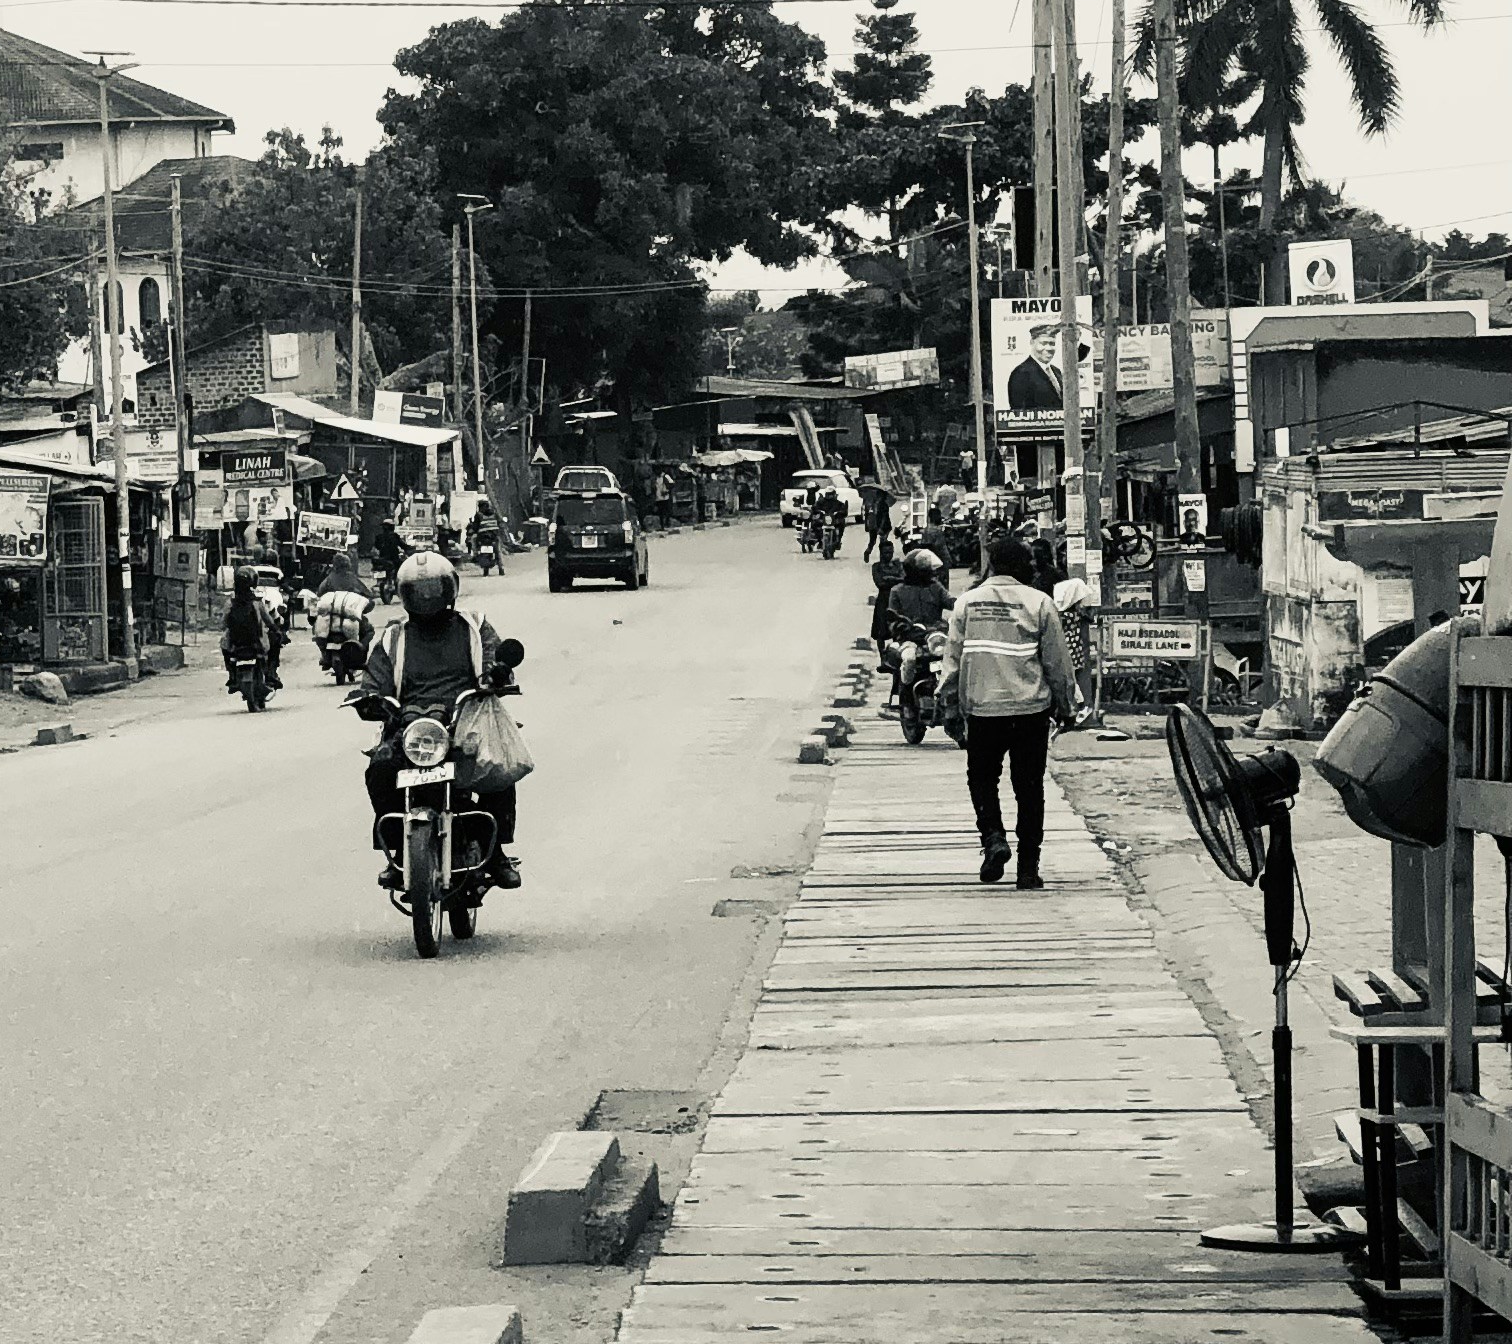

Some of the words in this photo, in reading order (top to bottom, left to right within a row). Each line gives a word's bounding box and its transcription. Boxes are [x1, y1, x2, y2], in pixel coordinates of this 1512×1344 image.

[1011, 298, 1062, 314] MAYO
[1150, 321, 1215, 336] BAING
[998, 410, 1035, 422] HAJJI
[1038, 409, 1093, 421] NORAN
[235, 456, 272, 471] LINAH
[225, 470, 256, 481] MEDICAL
[257, 468, 285, 479] CENTRE
[1120, 639, 1153, 649] SIRAJE
[1155, 640, 1180, 650] LANE
